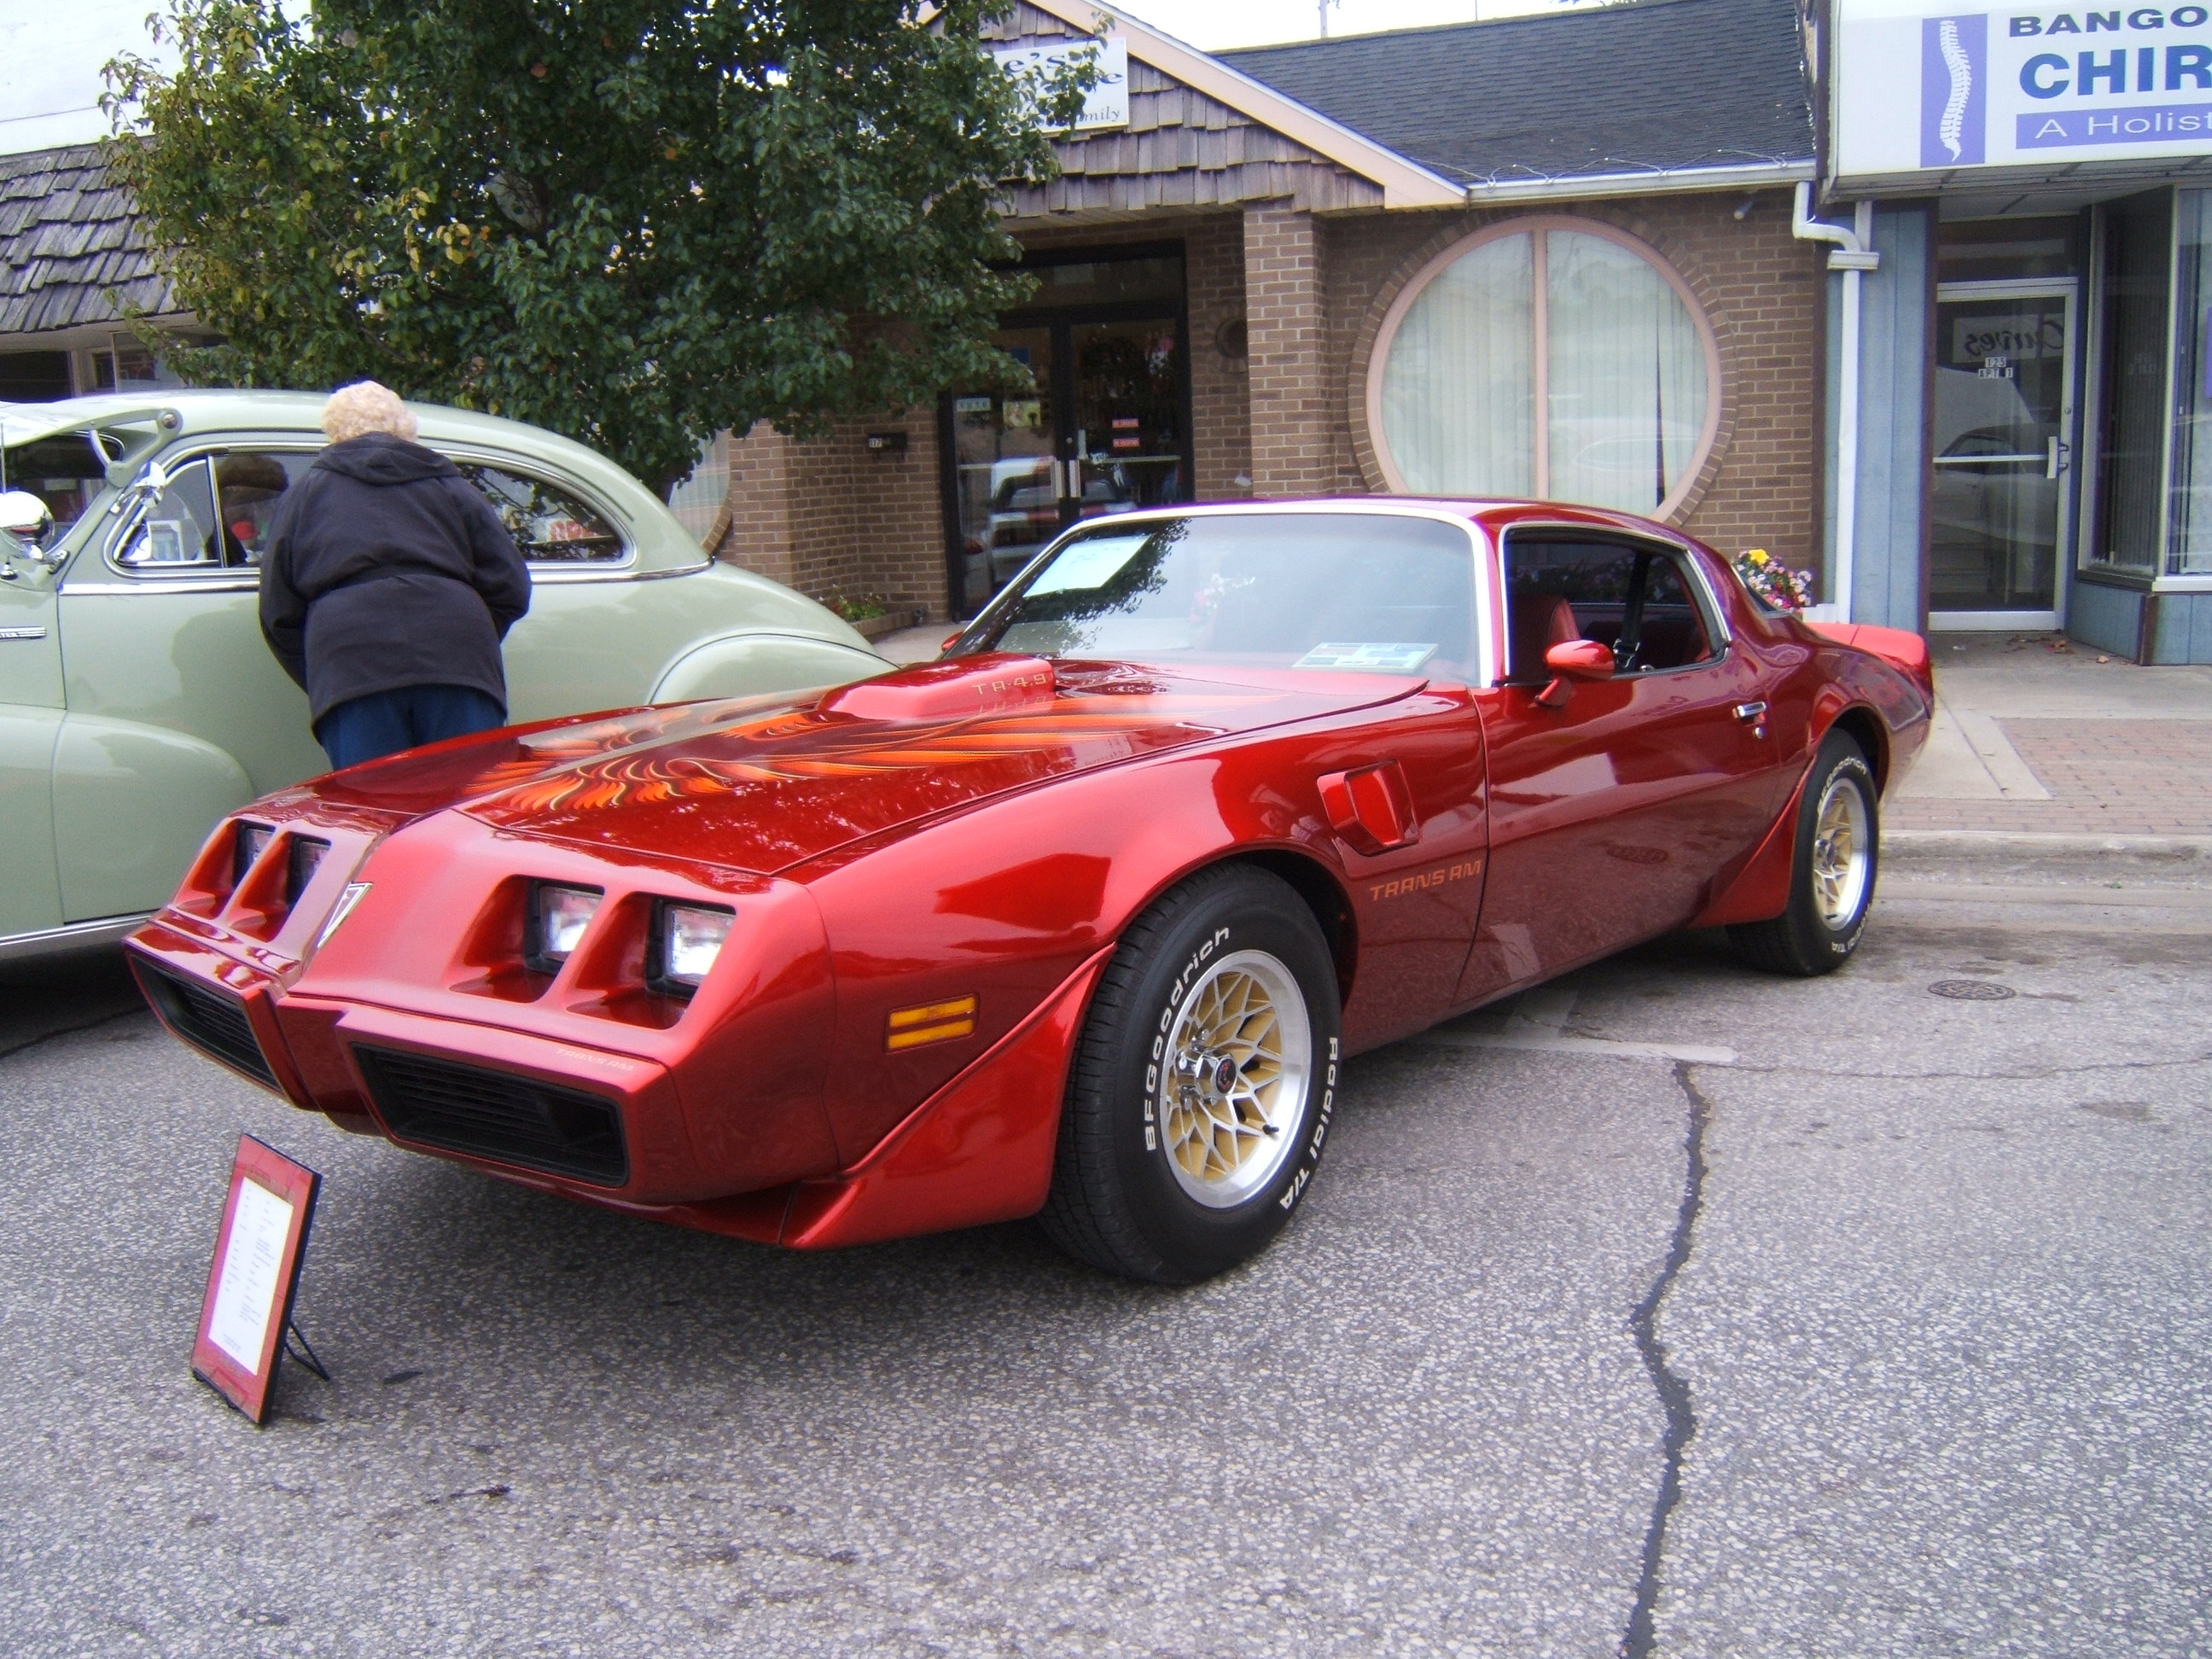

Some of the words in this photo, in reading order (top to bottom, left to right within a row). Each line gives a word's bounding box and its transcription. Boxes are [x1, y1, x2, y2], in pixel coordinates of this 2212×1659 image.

[2010, 6, 2209, 38] BANGO
[1003, 52, 1066, 73] e's
[2019, 44, 2212, 99] CHIR
[2034, 119, 2068, 140] A
[2088, 111, 2212, 136] Holist
[1370, 870, 1446, 901] TRANS
[1449, 860, 1482, 881] AM
[1144, 926, 1230, 1151] BFGoodrich
[1309, 1037, 1339, 1160] Radial
[1279, 1167, 1311, 1210] T/A
